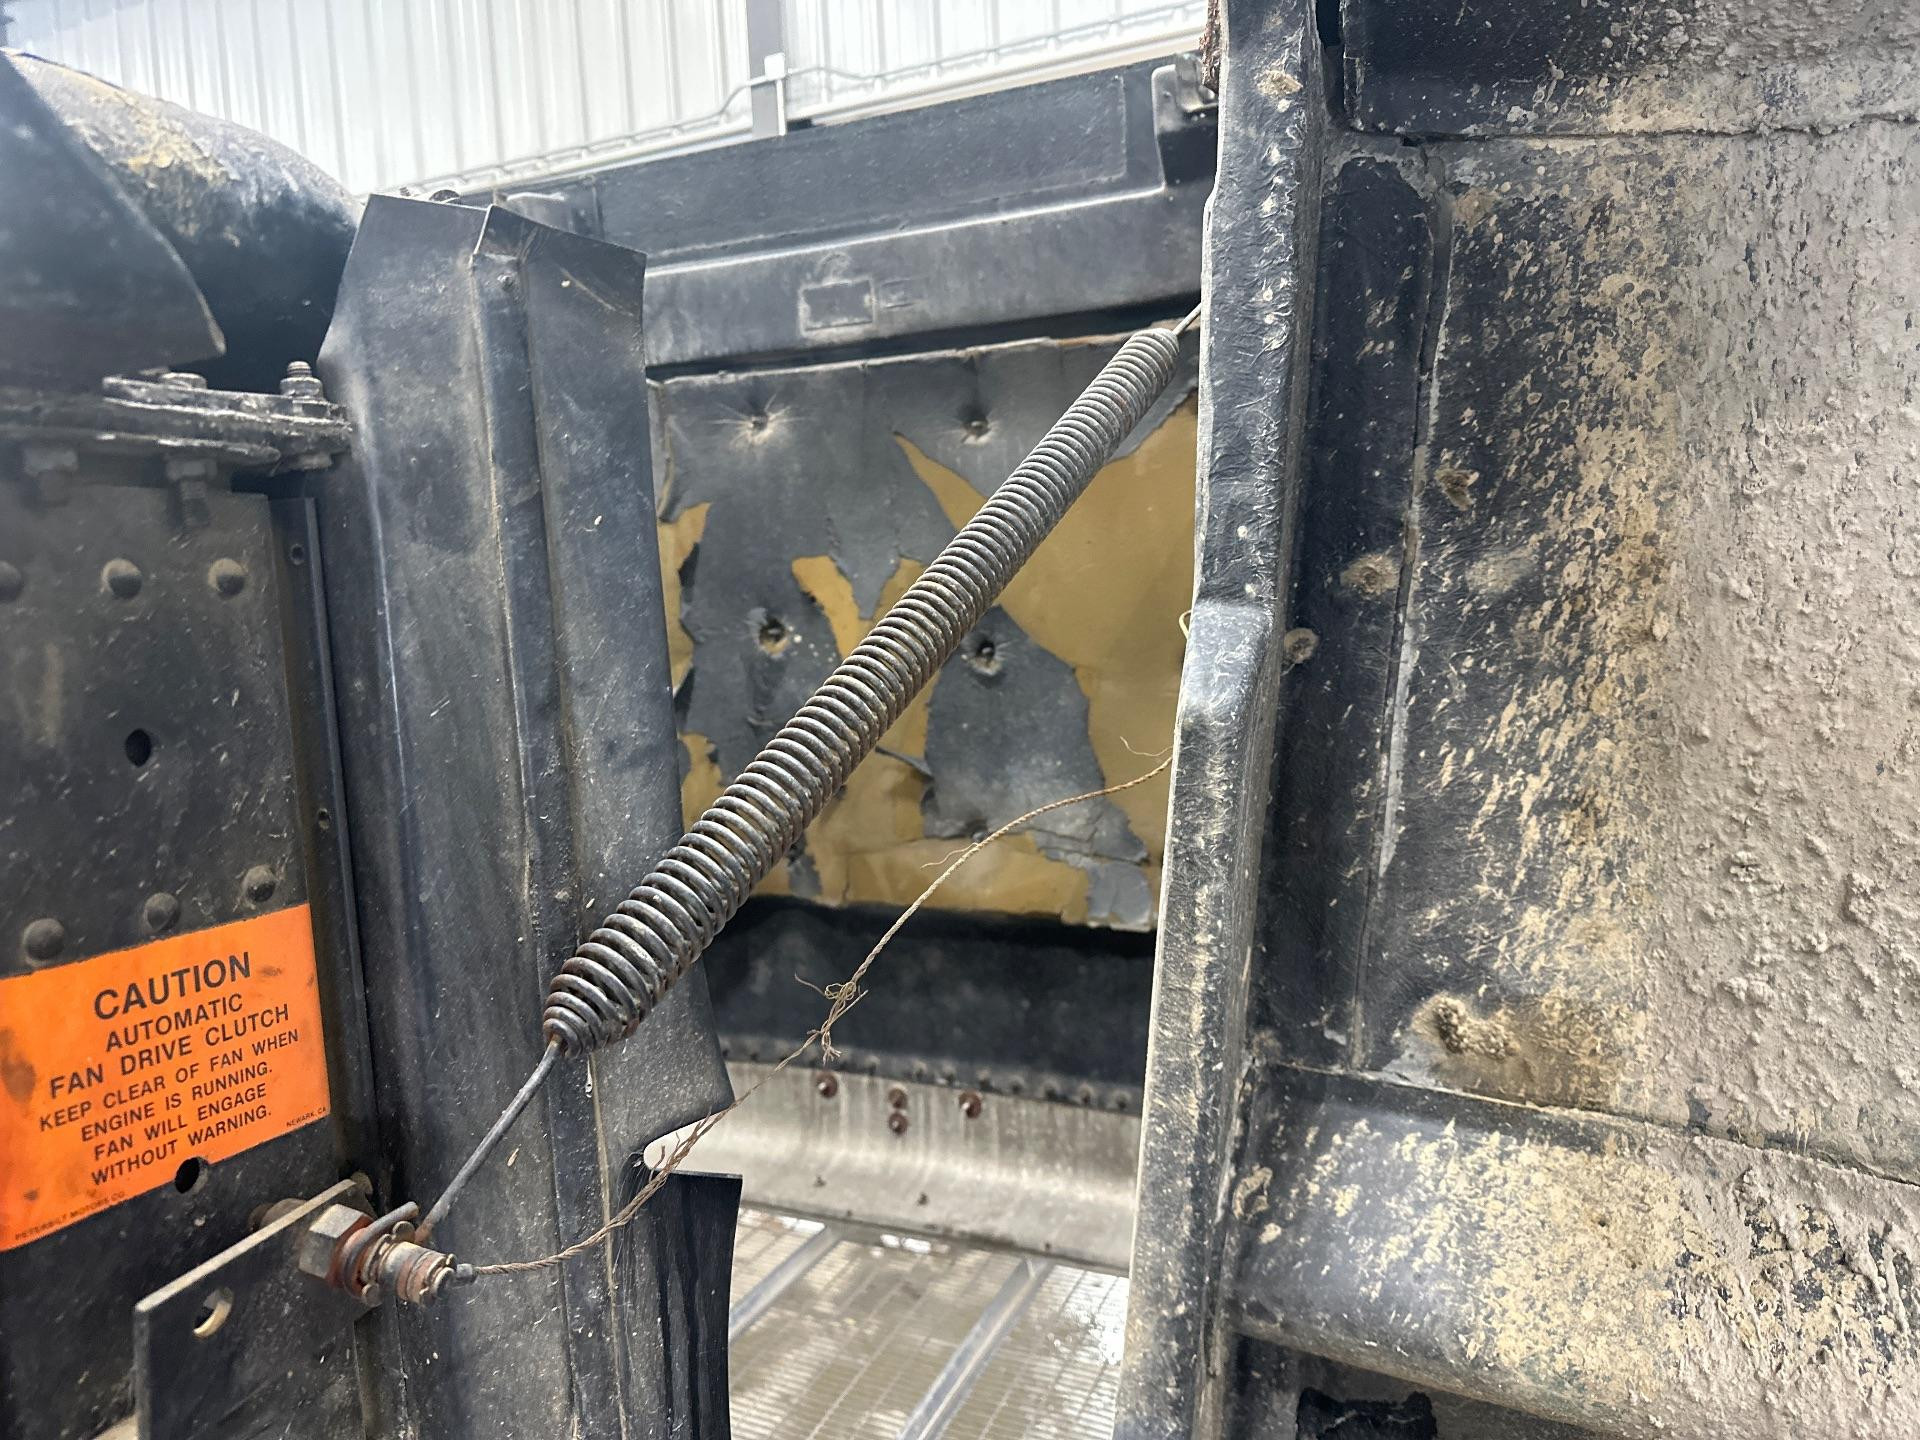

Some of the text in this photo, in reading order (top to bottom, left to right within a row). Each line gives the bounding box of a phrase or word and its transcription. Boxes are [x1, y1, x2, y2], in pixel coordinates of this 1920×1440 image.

[94, 951, 251, 1020] CAUTION
[106, 993, 243, 1052] AUTOMATIC
[39, 1028, 299, 1132] KEEP CLEAR OF FAN WHEN
[50, 1003, 289, 1099] FAN DRIVE CLUTCH
[81, 1060, 273, 1142] ENGINE IS RUNNING.
[94, 1082, 267, 1162] FAN WILL ENGAGE
[91, 1103, 272, 1186] WITHOUT WARNING.
